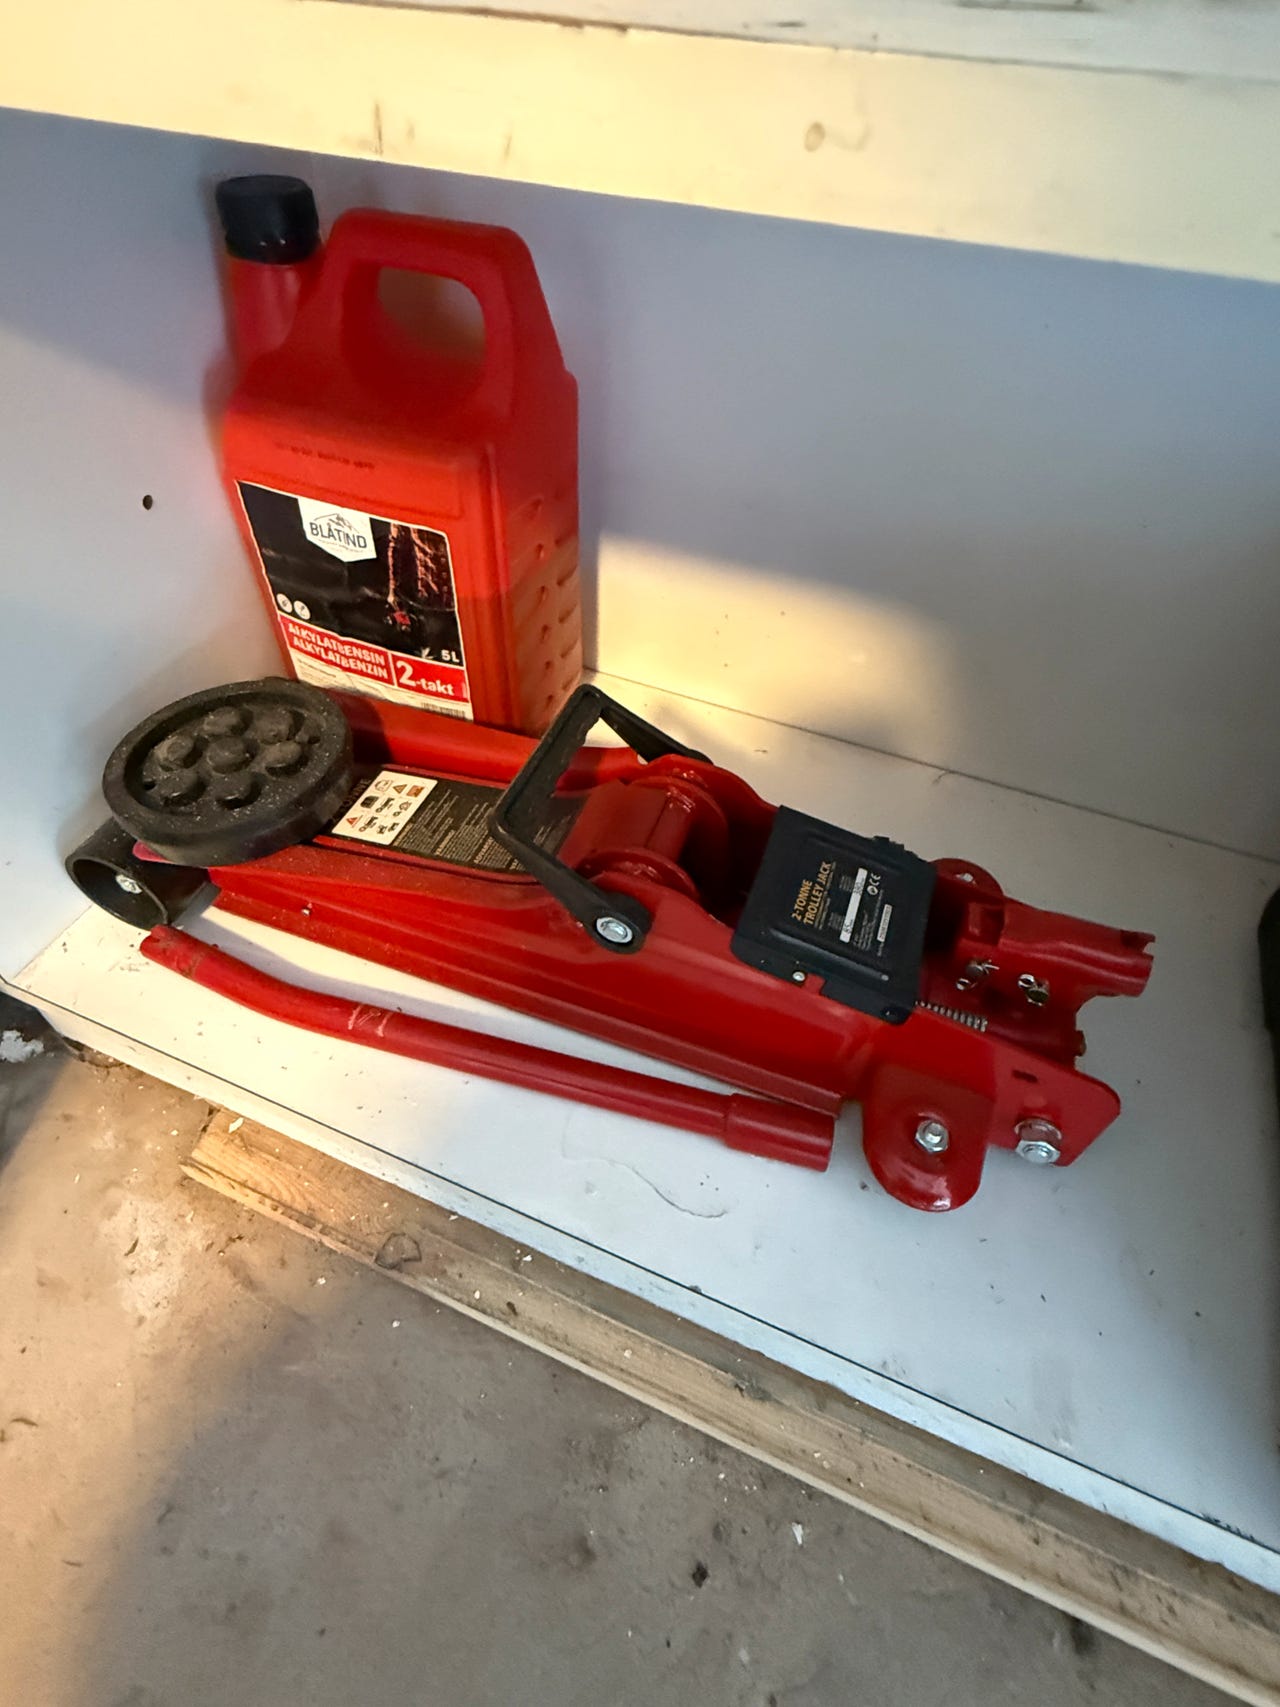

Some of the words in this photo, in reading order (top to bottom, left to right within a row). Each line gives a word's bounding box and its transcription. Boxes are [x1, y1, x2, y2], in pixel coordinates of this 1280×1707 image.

[309, 521, 368, 549] BLÅTIND
[293, 637, 388, 679] ALKYLATBENZIN
[396, 660, 454, 696] 2-takt
[792, 879, 813, 920] 2-TONNE
[804, 884, 823, 924] TROLLEY
[819, 861, 832, 883] JACK
